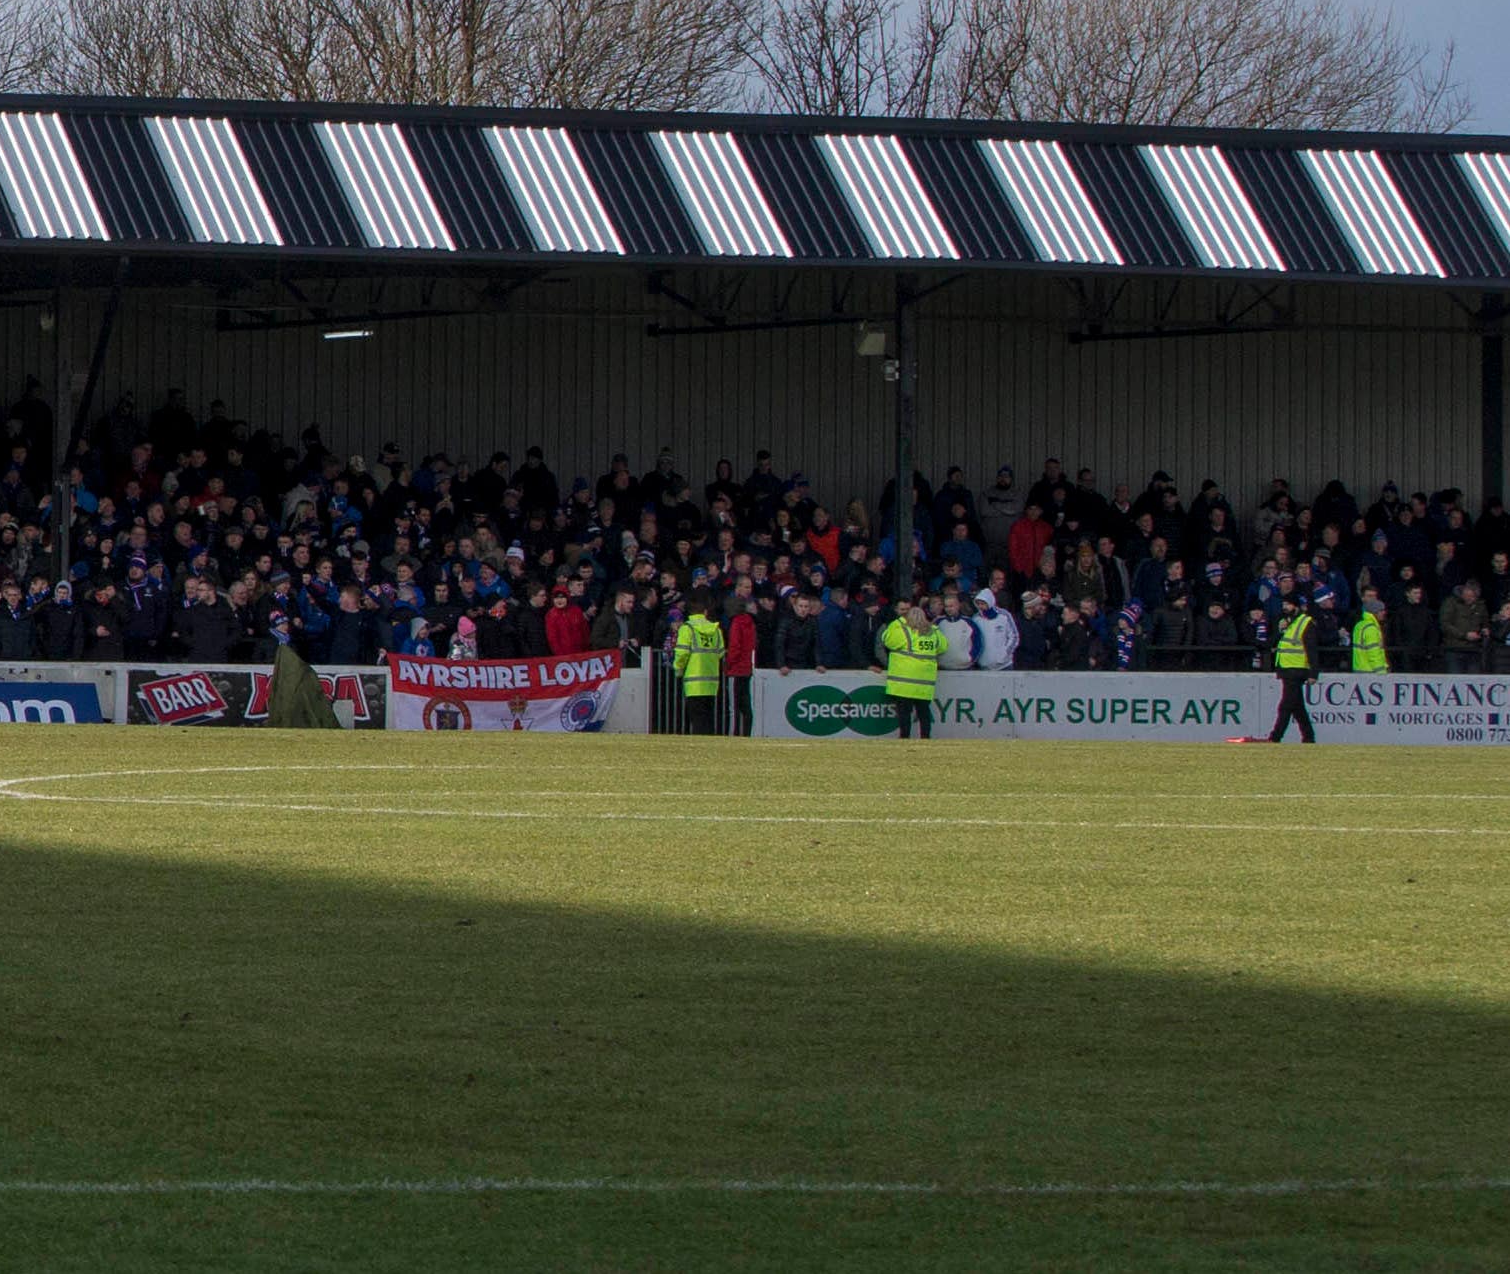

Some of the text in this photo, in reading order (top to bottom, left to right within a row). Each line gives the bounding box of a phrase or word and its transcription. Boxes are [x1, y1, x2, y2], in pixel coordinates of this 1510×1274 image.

[398, 660, 531, 689] AYRSHIRE
[152, 677, 216, 714] BARR
[1305, 682, 1383, 706] UCAS
[797, 699, 897, 722] Specsavers
[914, 698, 1241, 727] YR, AYR SUPER AYR
[1388, 713, 1483, 725] MORTGAGES
[1446, 727, 1483, 742] 0800
